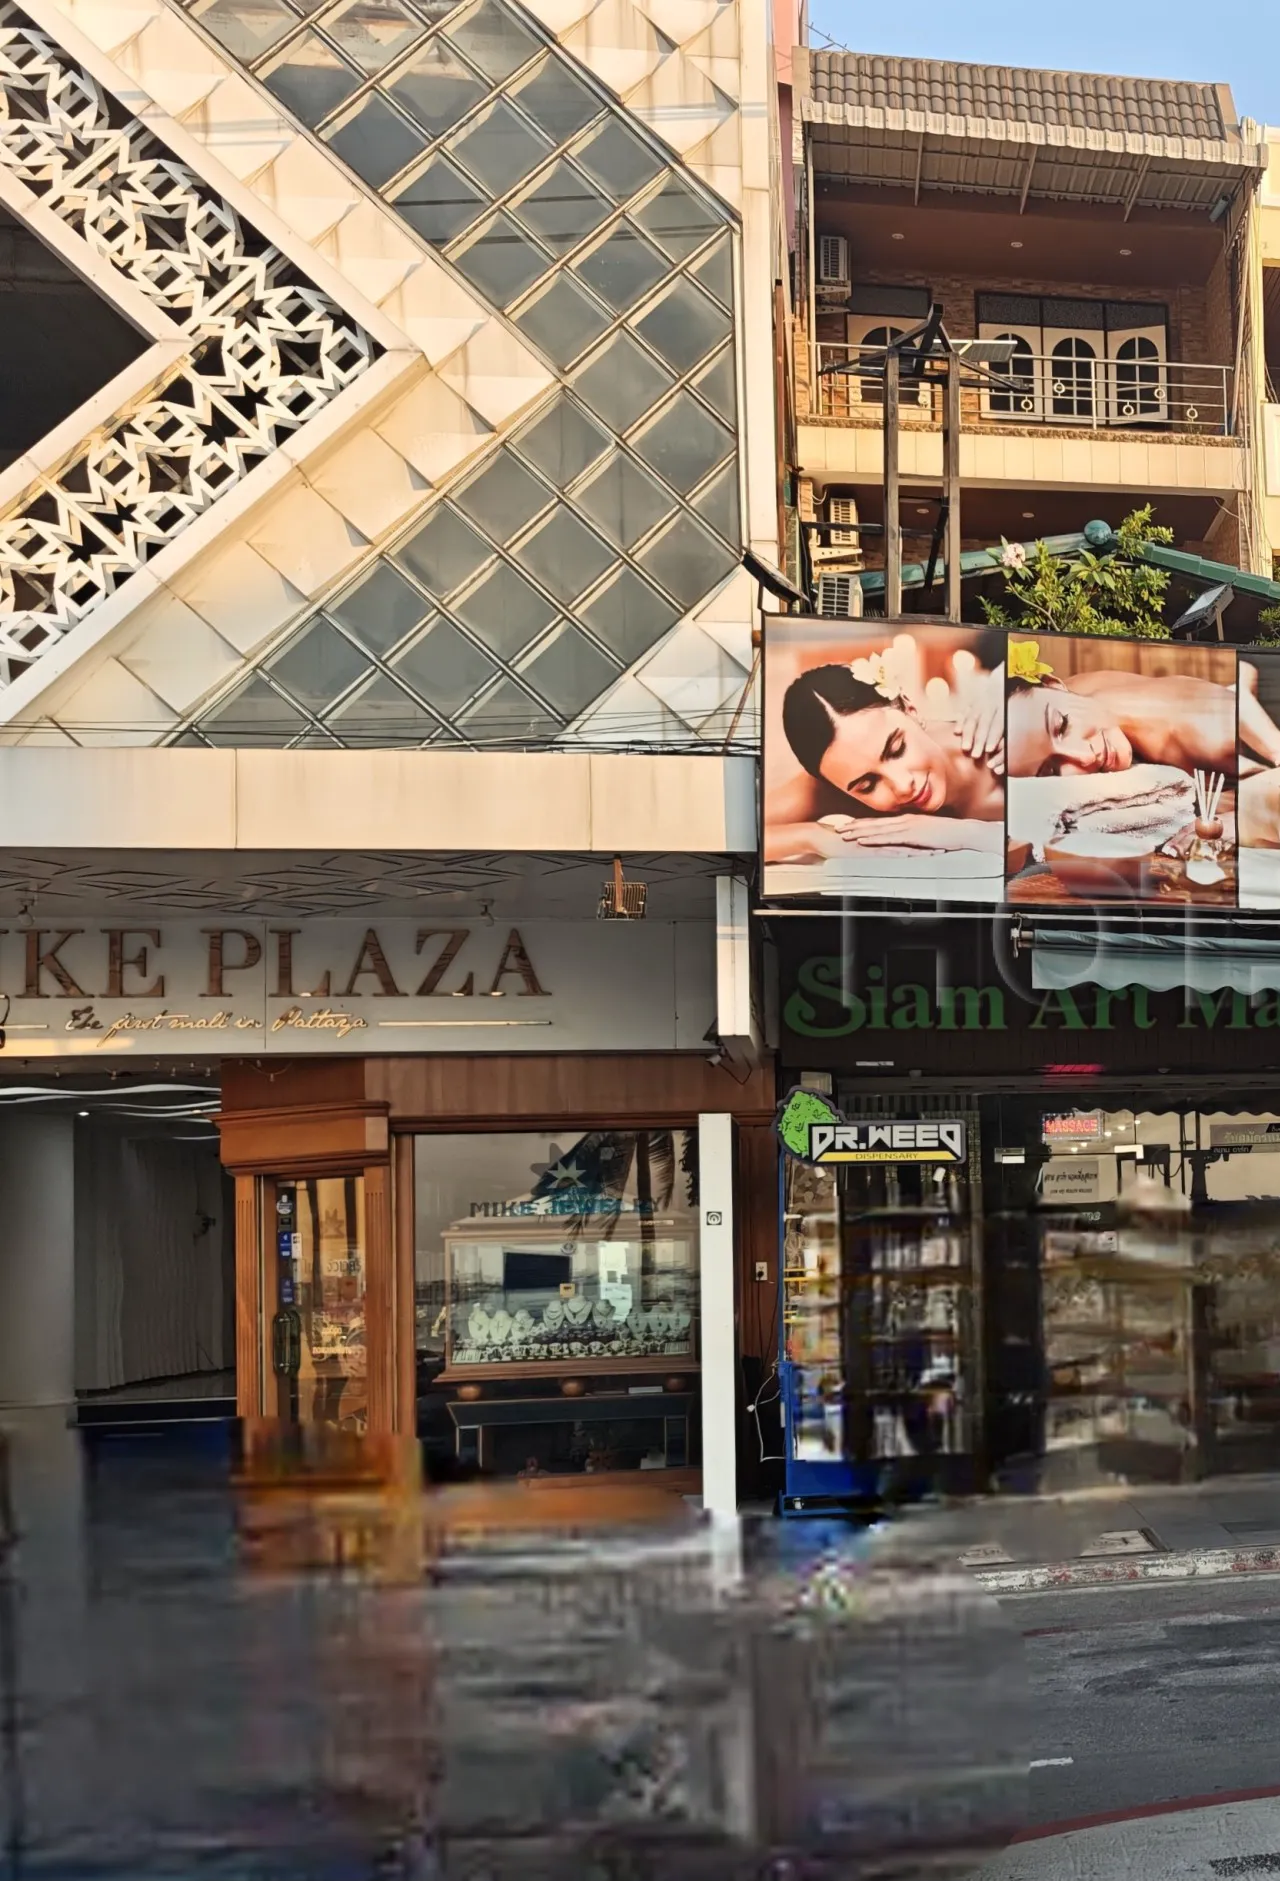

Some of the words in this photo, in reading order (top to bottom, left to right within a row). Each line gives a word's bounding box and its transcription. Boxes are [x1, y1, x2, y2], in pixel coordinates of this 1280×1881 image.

[0, 928, 165, 998] KE
[198, 928, 553, 998] PLAZA
[784, 955, 1010, 1038] Siam
[1031, 982, 1157, 1031] Art
[97, 1008, 190, 1047] first
[168, 1011, 234, 1030] mall
[234, 1014, 264, 1029] in
[270, 1005, 368, 1038] Pattaya
[1045, 1119, 1098, 1133] MASSAGE
[855, 1152, 919, 1160] DISPENSARY
[470, 1202, 534, 1217] MIKE
